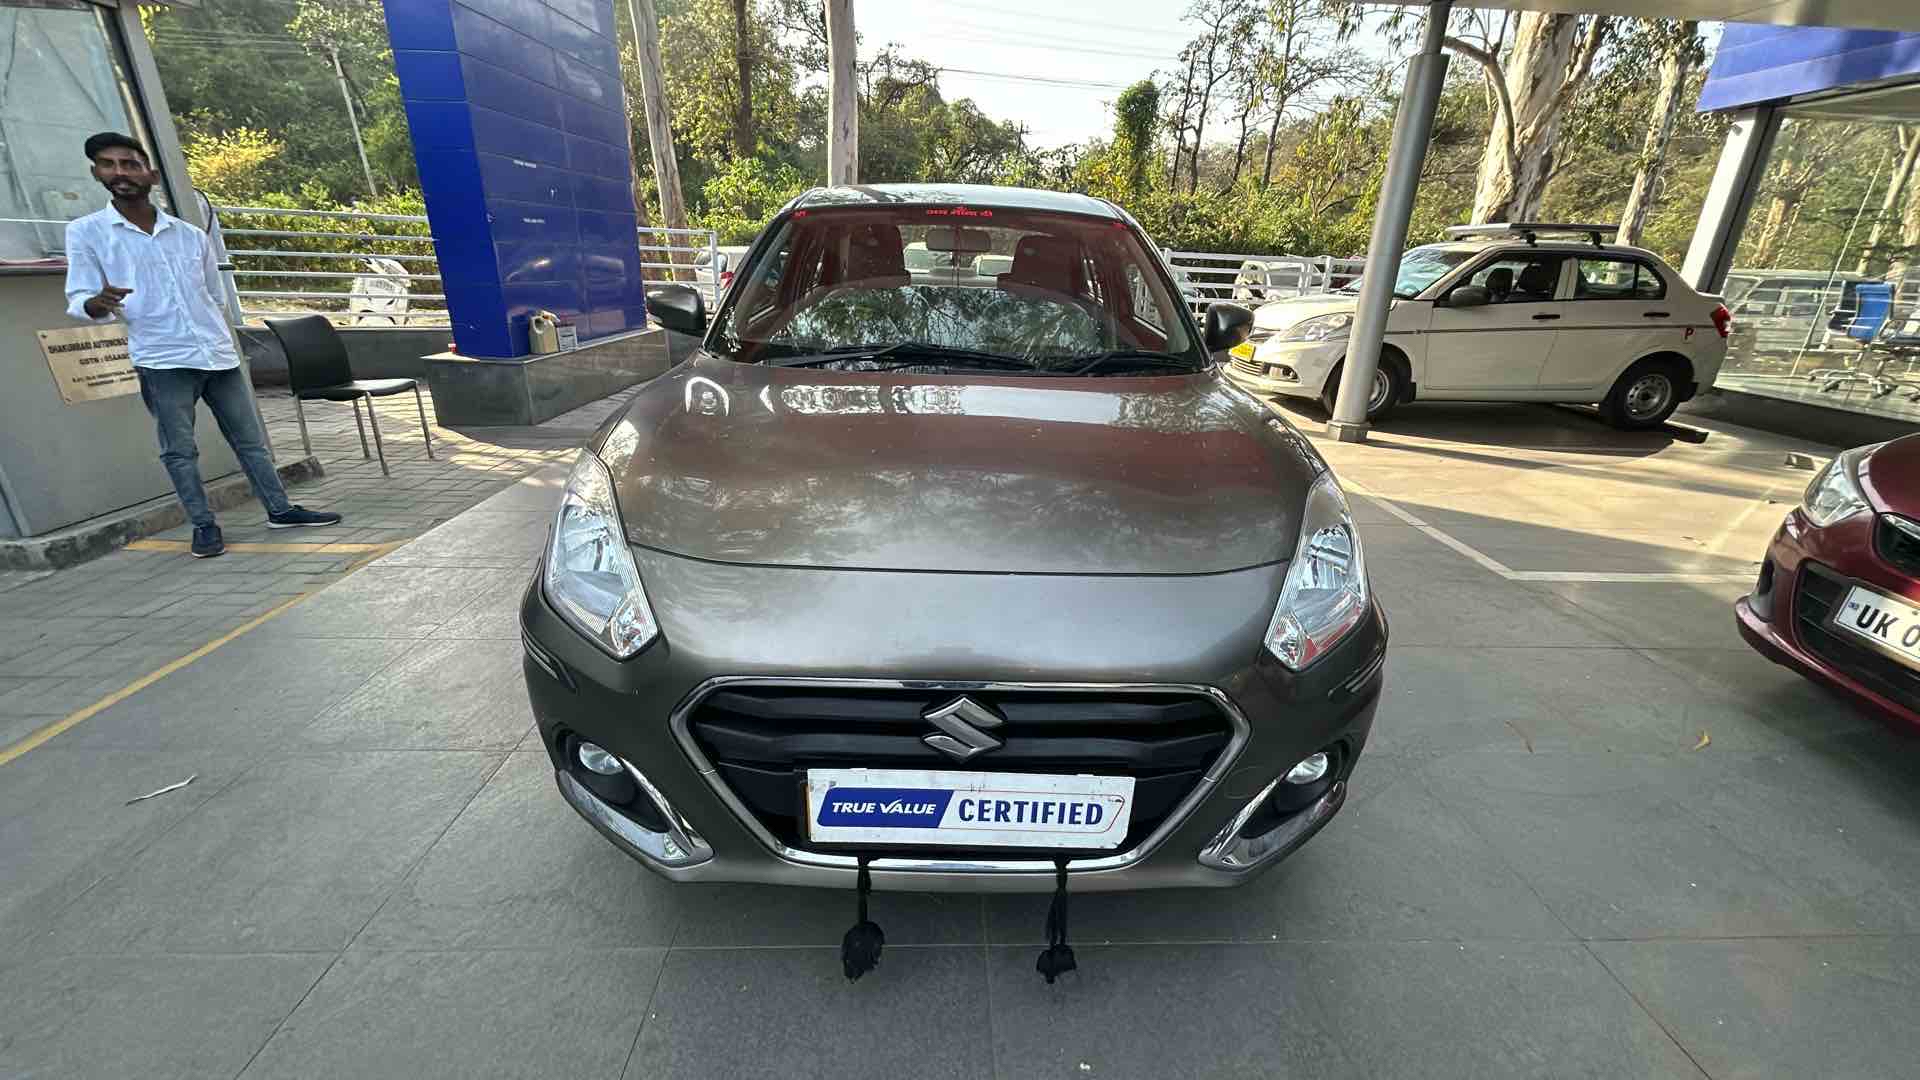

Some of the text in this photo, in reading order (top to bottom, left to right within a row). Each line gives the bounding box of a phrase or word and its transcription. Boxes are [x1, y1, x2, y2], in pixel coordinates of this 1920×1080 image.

[1684, 327, 1695, 341] P
[1856, 604, 1899, 638] UK
[832, 798, 1103, 825] TRUE VALUE CERTIFIED
